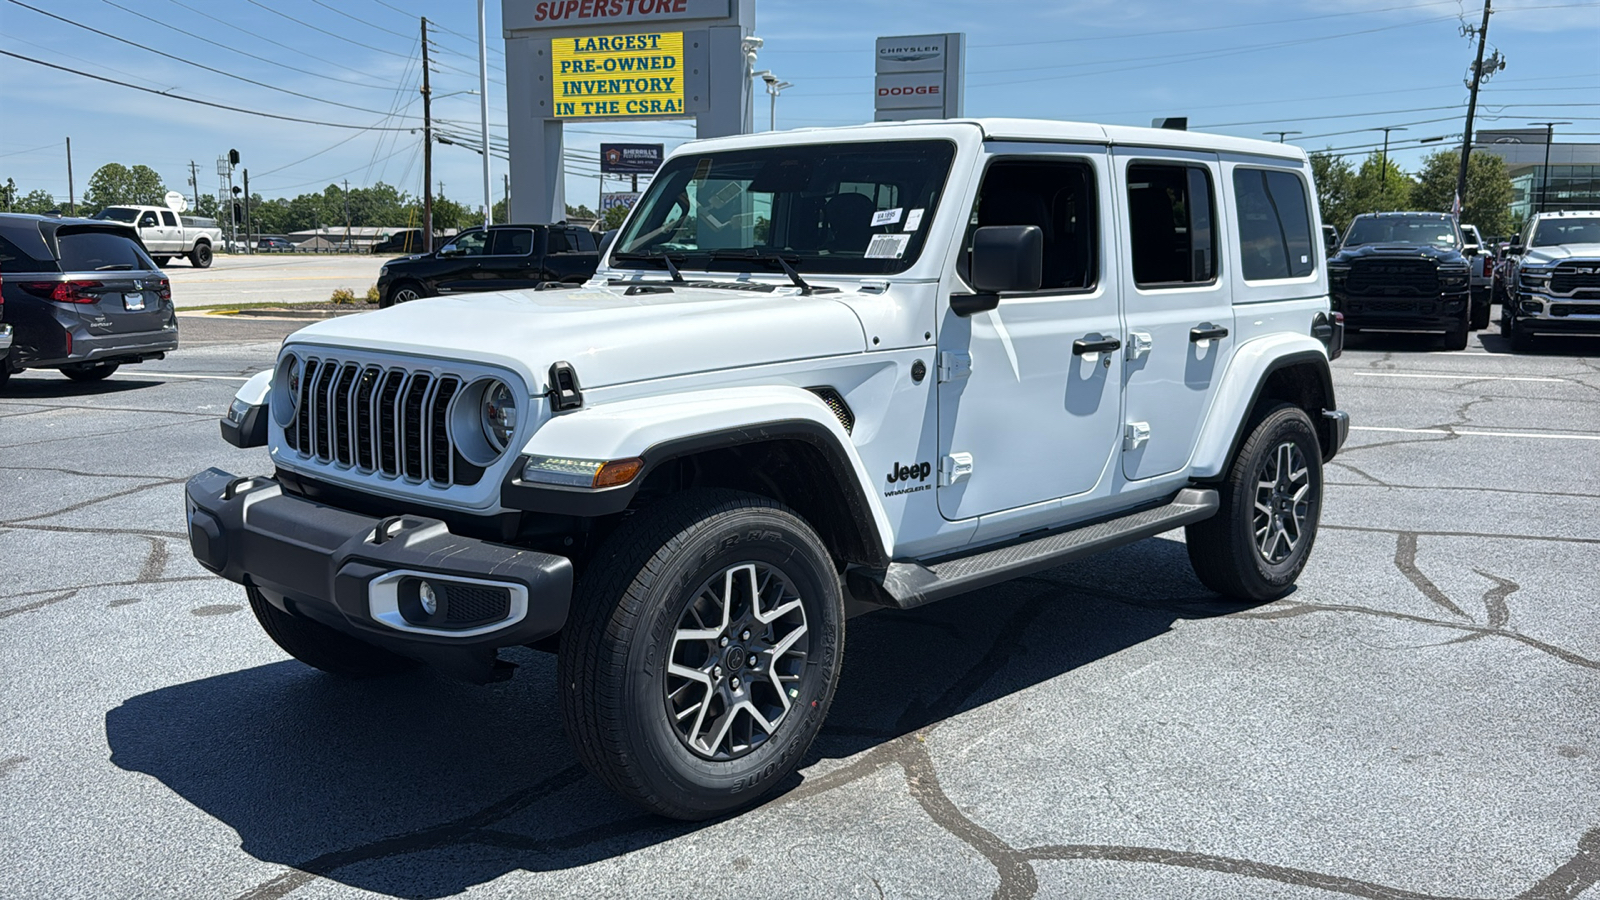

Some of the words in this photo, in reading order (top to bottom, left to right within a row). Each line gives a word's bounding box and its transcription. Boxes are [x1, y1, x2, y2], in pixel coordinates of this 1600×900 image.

[534, 0, 687, 21] SUPERSTORE
[573, 34, 661, 52] LARGEST
[880, 46, 939, 54] CHRYSLER
[560, 55, 676, 74] PRE-OWNED
[562, 77, 675, 95] INVENTORY
[878, 86, 940, 96] DODGE
[555, 102, 575, 115] IN
[581, 101, 620, 114] THE
[626, 98, 683, 113] CSRA!
[886, 461, 931, 483] Jeep
[884, 485, 925, 497] WRANGLER
